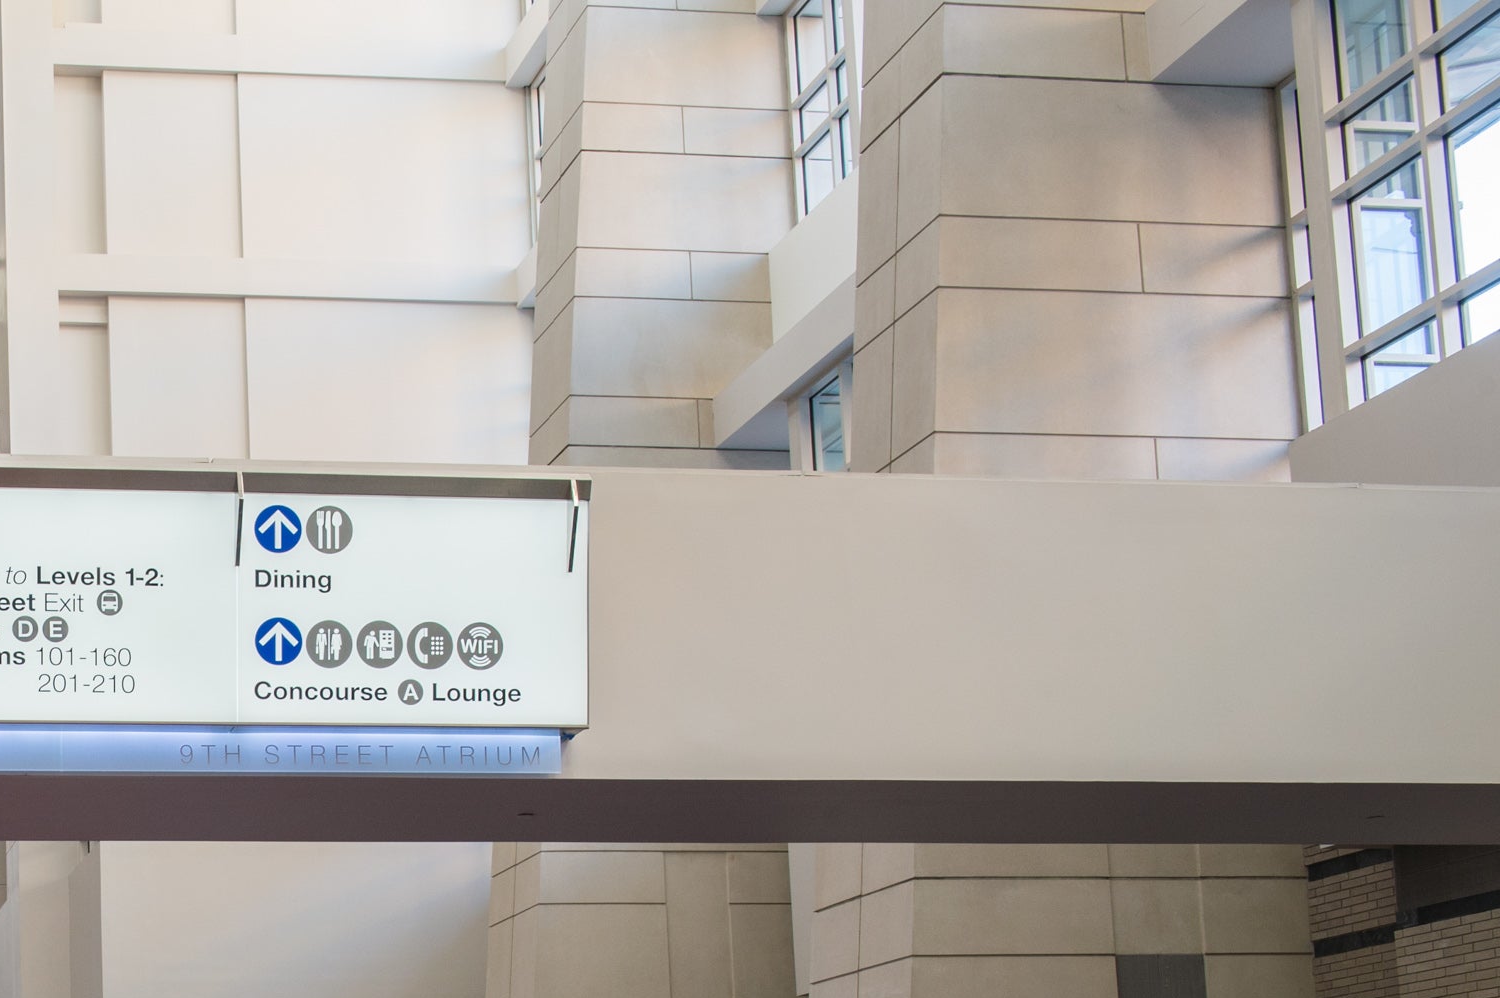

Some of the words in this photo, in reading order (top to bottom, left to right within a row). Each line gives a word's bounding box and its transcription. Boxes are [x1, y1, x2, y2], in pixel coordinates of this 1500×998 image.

[5, 566, 28, 585] to
[35, 566, 116, 586] Levels
[125, 568, 164, 587] 1-2:
[254, 569, 332, 593] Dining
[43, 592, 84, 613] Exit
[36, 646, 132, 667] 101-160
[37, 673, 136, 694] 201-210
[253, 681, 388, 702] Concourse
[432, 683, 522, 707] Lounge
[179, 744, 242, 766] 9TH
[264, 744, 395, 766] STREET
[415, 745, 541, 766] ATRIUM
